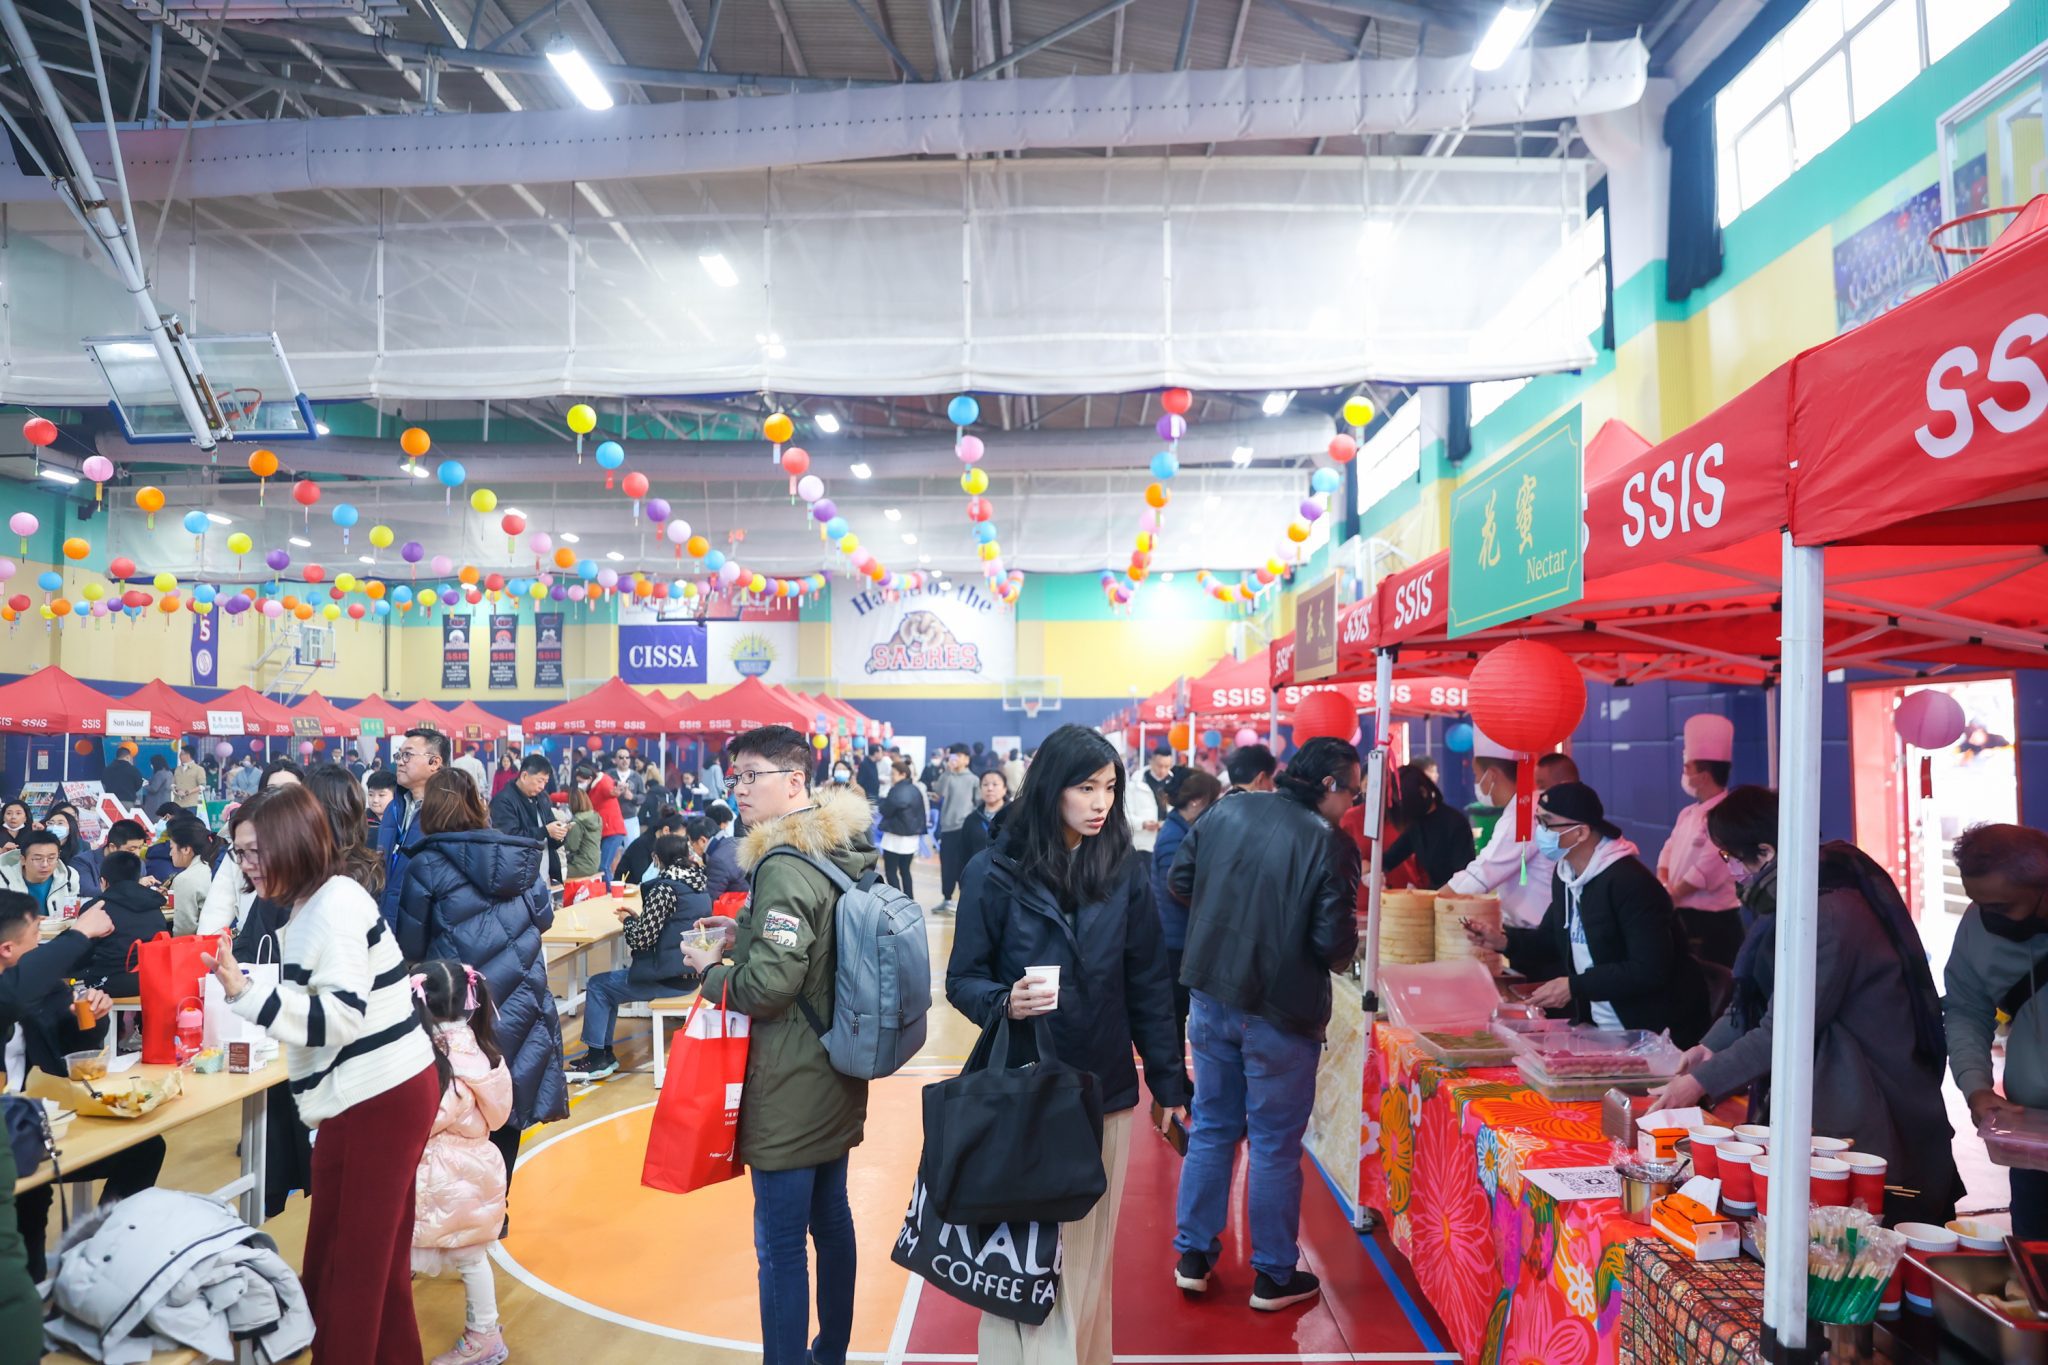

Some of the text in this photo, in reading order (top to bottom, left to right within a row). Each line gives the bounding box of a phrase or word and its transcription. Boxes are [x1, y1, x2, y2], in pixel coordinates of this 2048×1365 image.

[1622, 442, 1726, 547] SSIS
[1526, 549, 1568, 584] Nectar
[957, 583, 992, 614] the
[1393, 569, 1434, 630] SSIS
[1343, 602, 1373, 644] SSIS
[629, 645, 699, 668] CISSA
[872, 644, 978, 670] SABRES
[1212, 687, 1266, 708] SSIS
[82, 719, 101, 729] SSIS
[113, 719, 144, 728] Sun Island
[623, 720, 646, 730] SSIS
[679, 720, 702, 729] SSIS
[709, 719, 732, 729] SSIS
[931, 1254, 1024, 1303] COFFEE
